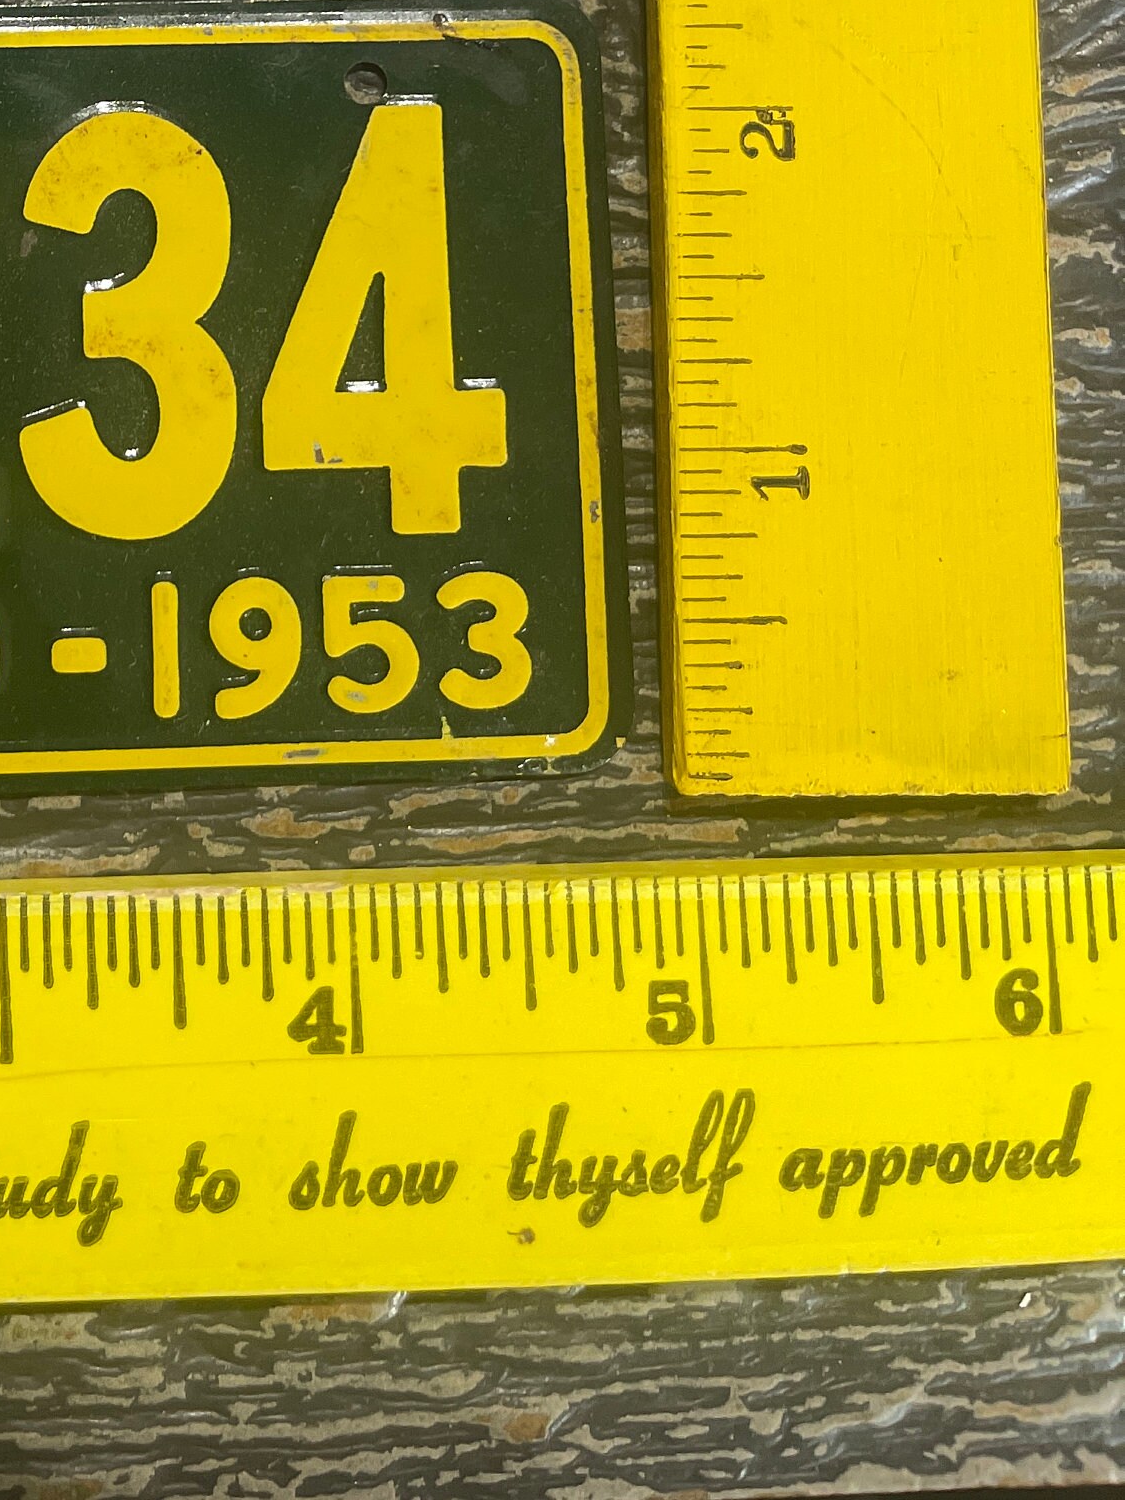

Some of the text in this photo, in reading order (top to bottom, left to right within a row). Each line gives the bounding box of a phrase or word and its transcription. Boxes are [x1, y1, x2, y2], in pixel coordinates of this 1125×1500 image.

[739, 110, 796, 162] 2
[750, 465, 811, 501] 1
[151, 571, 533, 720] 1953
[286, 986, 347, 1055] 4
[646, 979, 697, 1046] 5
[993, 968, 1044, 1036] 6
[174, 1141, 241, 1214] to
[288, 1110, 458, 1211] show
[507, 1088, 756, 1228] thyself
[779, 1081, 1092, 1219] approved
